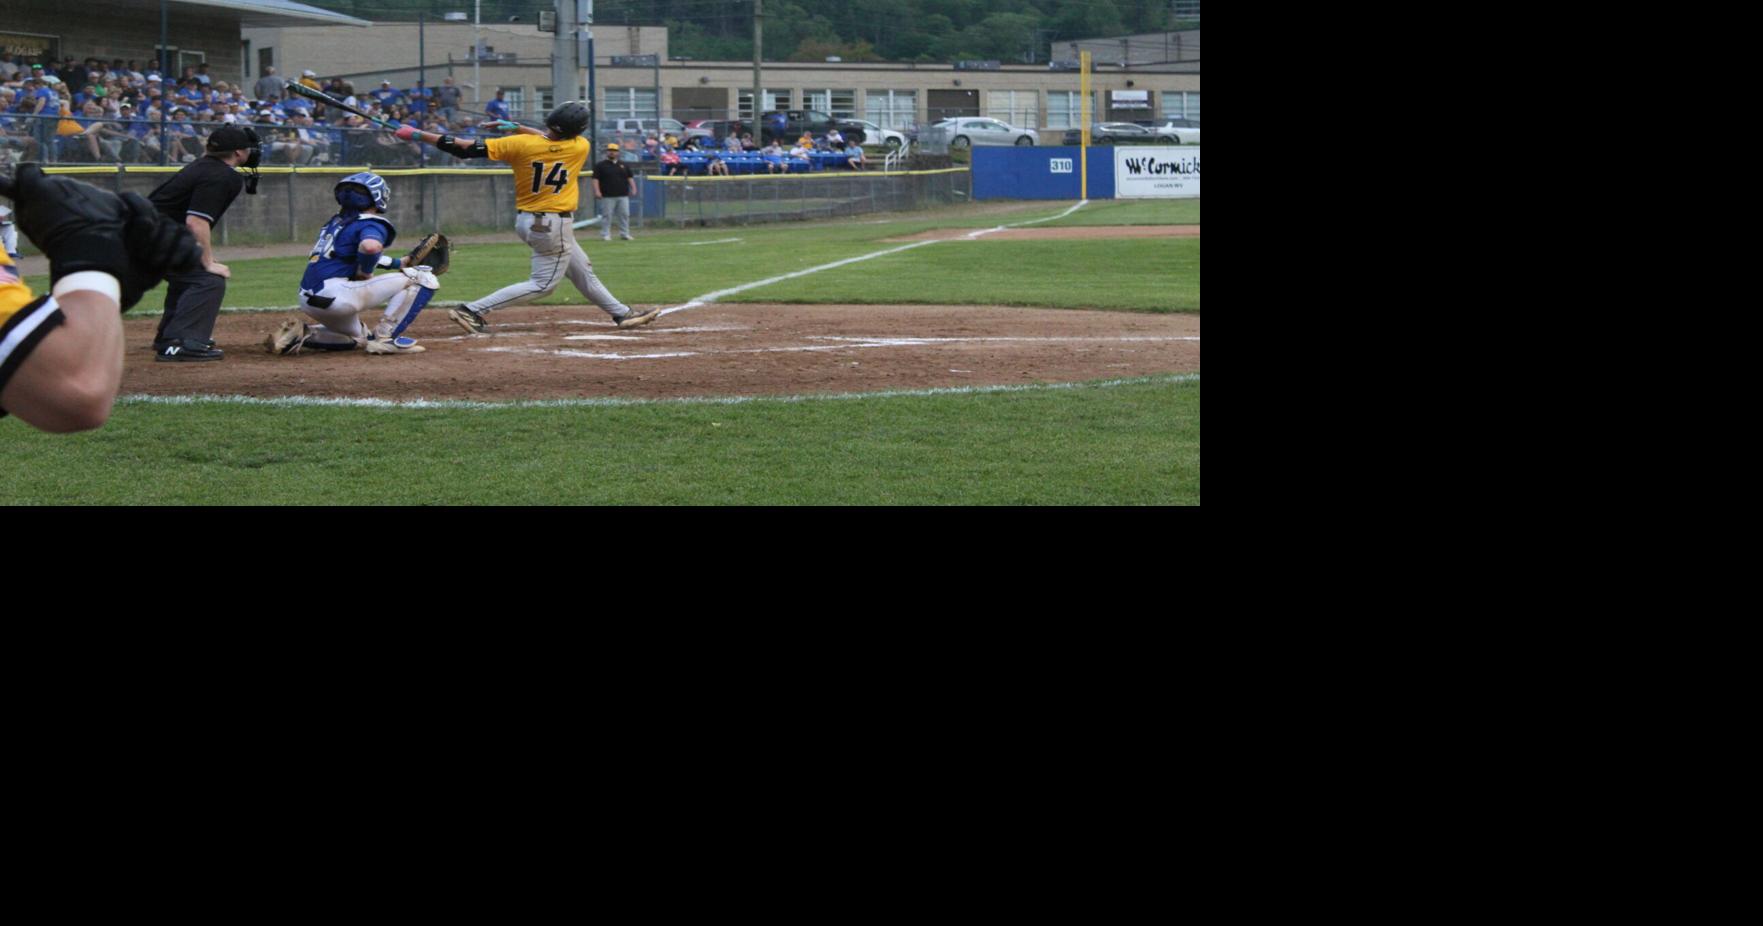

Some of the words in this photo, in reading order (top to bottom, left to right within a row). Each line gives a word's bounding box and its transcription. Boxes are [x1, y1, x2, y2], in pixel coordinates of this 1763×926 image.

[1052, 160, 1071, 170] 310
[531, 160, 568, 194] 14
[165, 346, 180, 355] N
